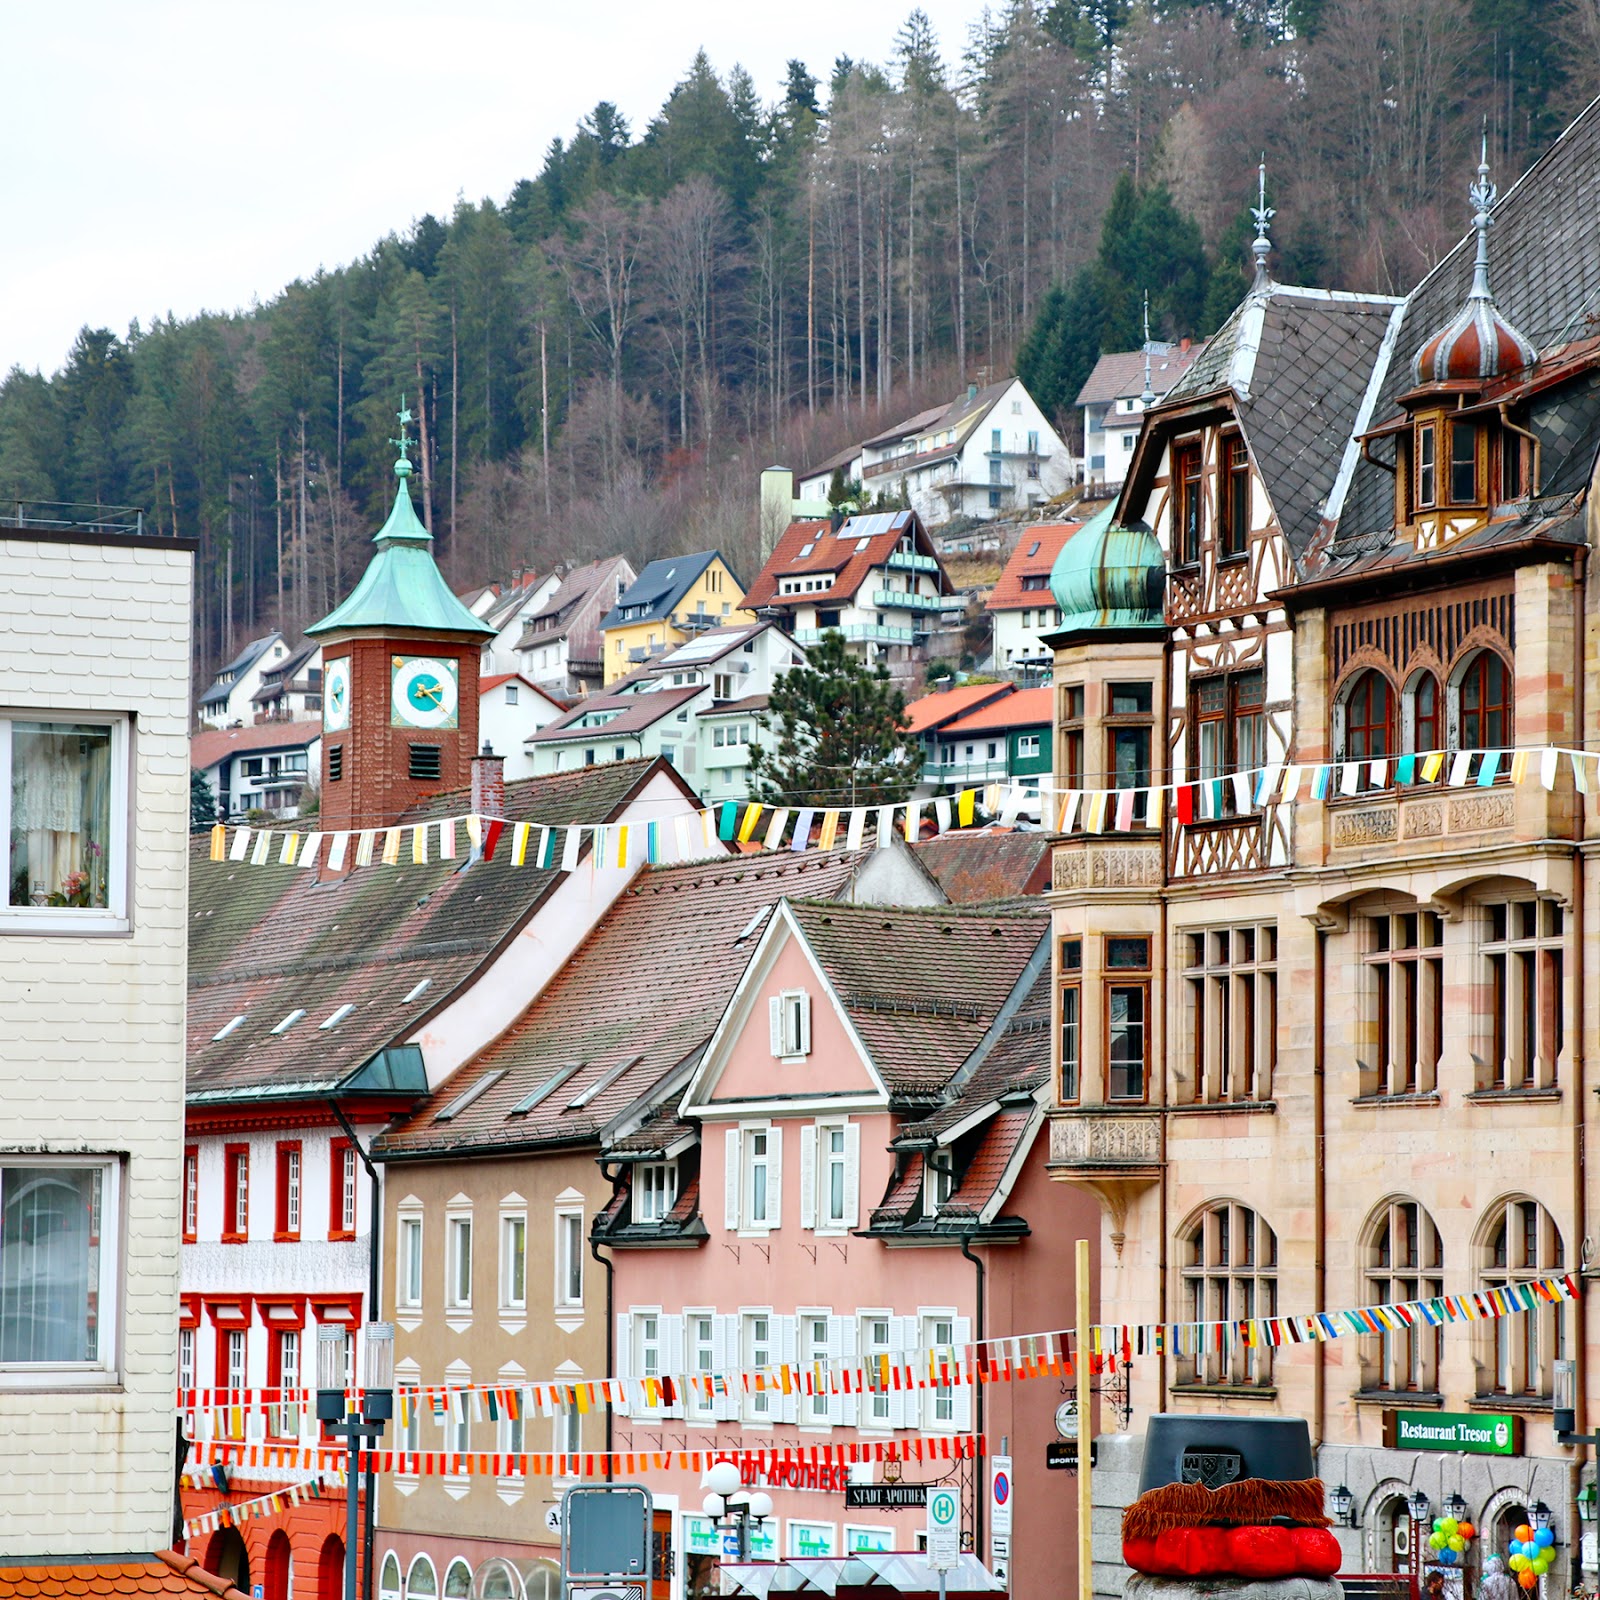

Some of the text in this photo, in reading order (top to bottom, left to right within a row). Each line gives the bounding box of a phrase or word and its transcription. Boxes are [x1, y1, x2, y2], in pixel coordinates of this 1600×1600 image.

[1401, 1421, 1456, 1440] Restaurant
[1458, 1423, 1492, 1442] Tresor
[853, 1488, 927, 1504] STADT-APOTHEK
[1490, 1488, 1532, 1512] RESTAURA
[938, 1500, 949, 1518] H
